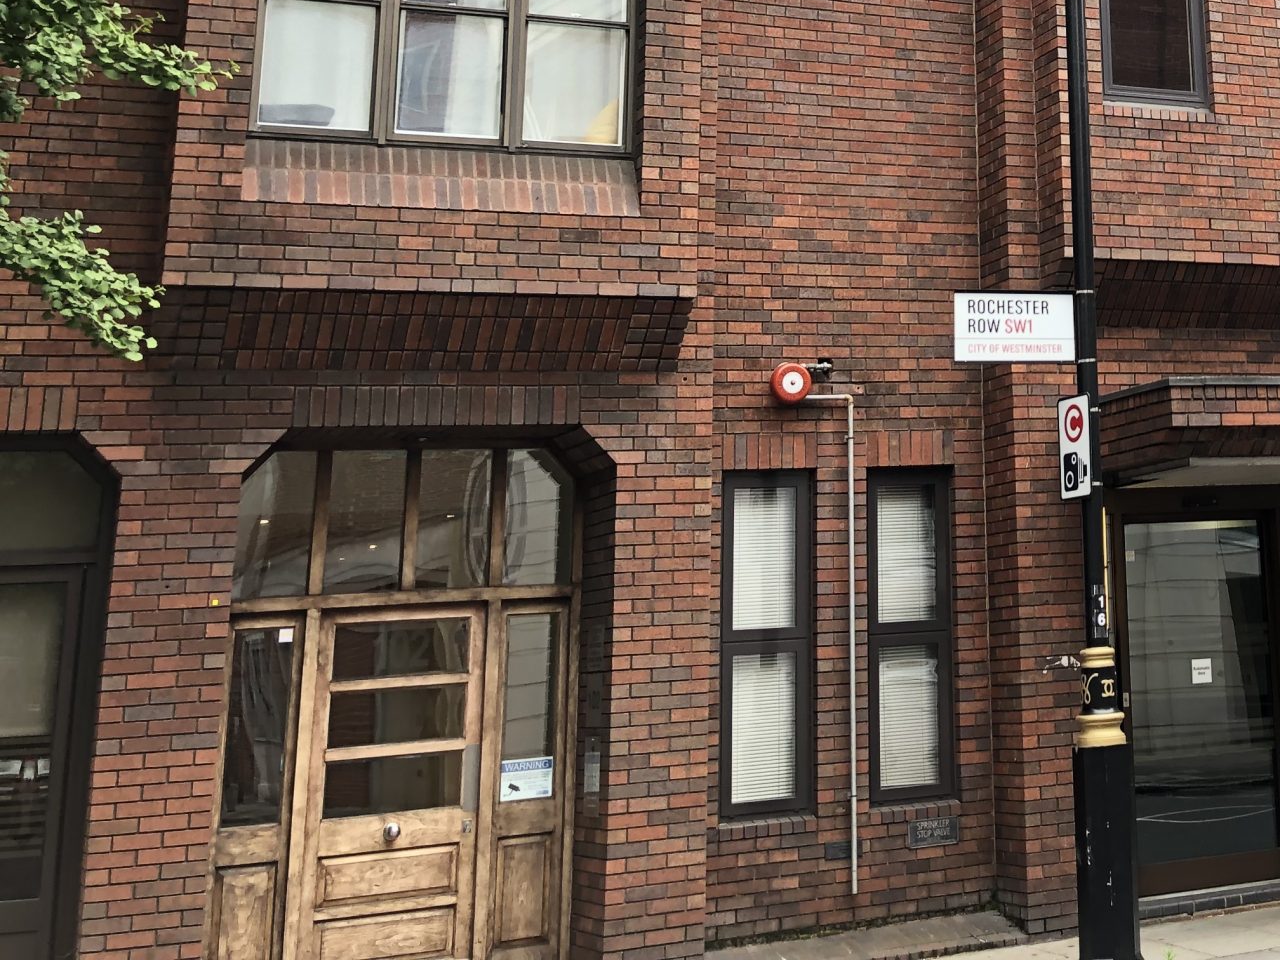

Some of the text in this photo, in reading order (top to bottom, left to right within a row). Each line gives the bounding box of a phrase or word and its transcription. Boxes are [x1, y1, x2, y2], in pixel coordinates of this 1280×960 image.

[967, 299, 1049, 315] ROCHESTER
[968, 318, 1033, 334] ROW SW1
[968, 344, 1063, 353] CITY OF WESTMINSTER
[504, 759, 550, 772] WARNING
[916, 819, 950, 830] SPRINKLER
[916, 827, 950, 838] STOP VALVE
